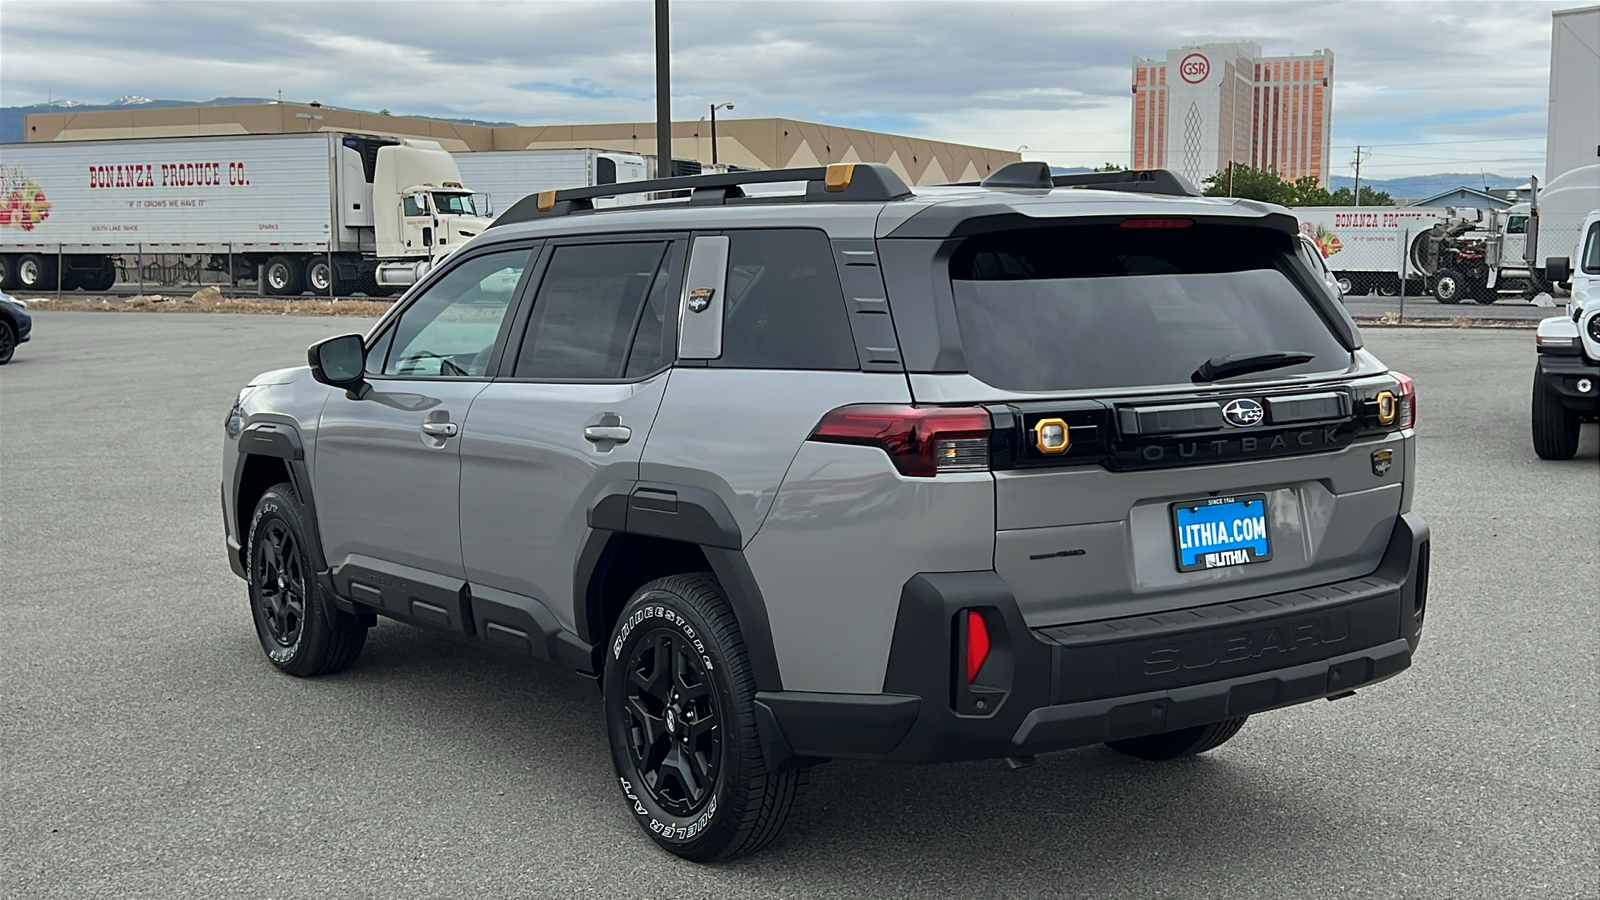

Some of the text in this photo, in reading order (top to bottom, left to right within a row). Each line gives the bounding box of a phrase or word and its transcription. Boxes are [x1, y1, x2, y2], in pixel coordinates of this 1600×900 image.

[1183, 62, 1206, 75] GSR
[89, 162, 250, 188] BONANZA PRODUCE CO.
[180, 199, 197, 207] HAVE
[1335, 213, 1378, 228] BONANZA
[1142, 428, 1338, 461] OUTBACK
[1207, 498, 1223, 506] SINCE
[1179, 516, 1267, 550] LITHIA.COM
[1215, 549, 1250, 567] LITHIA
[613, 606, 714, 670] BRIDGESTONE
[1142, 613, 1349, 676] SUBARU
[620, 777, 718, 840] DUELER A/T
